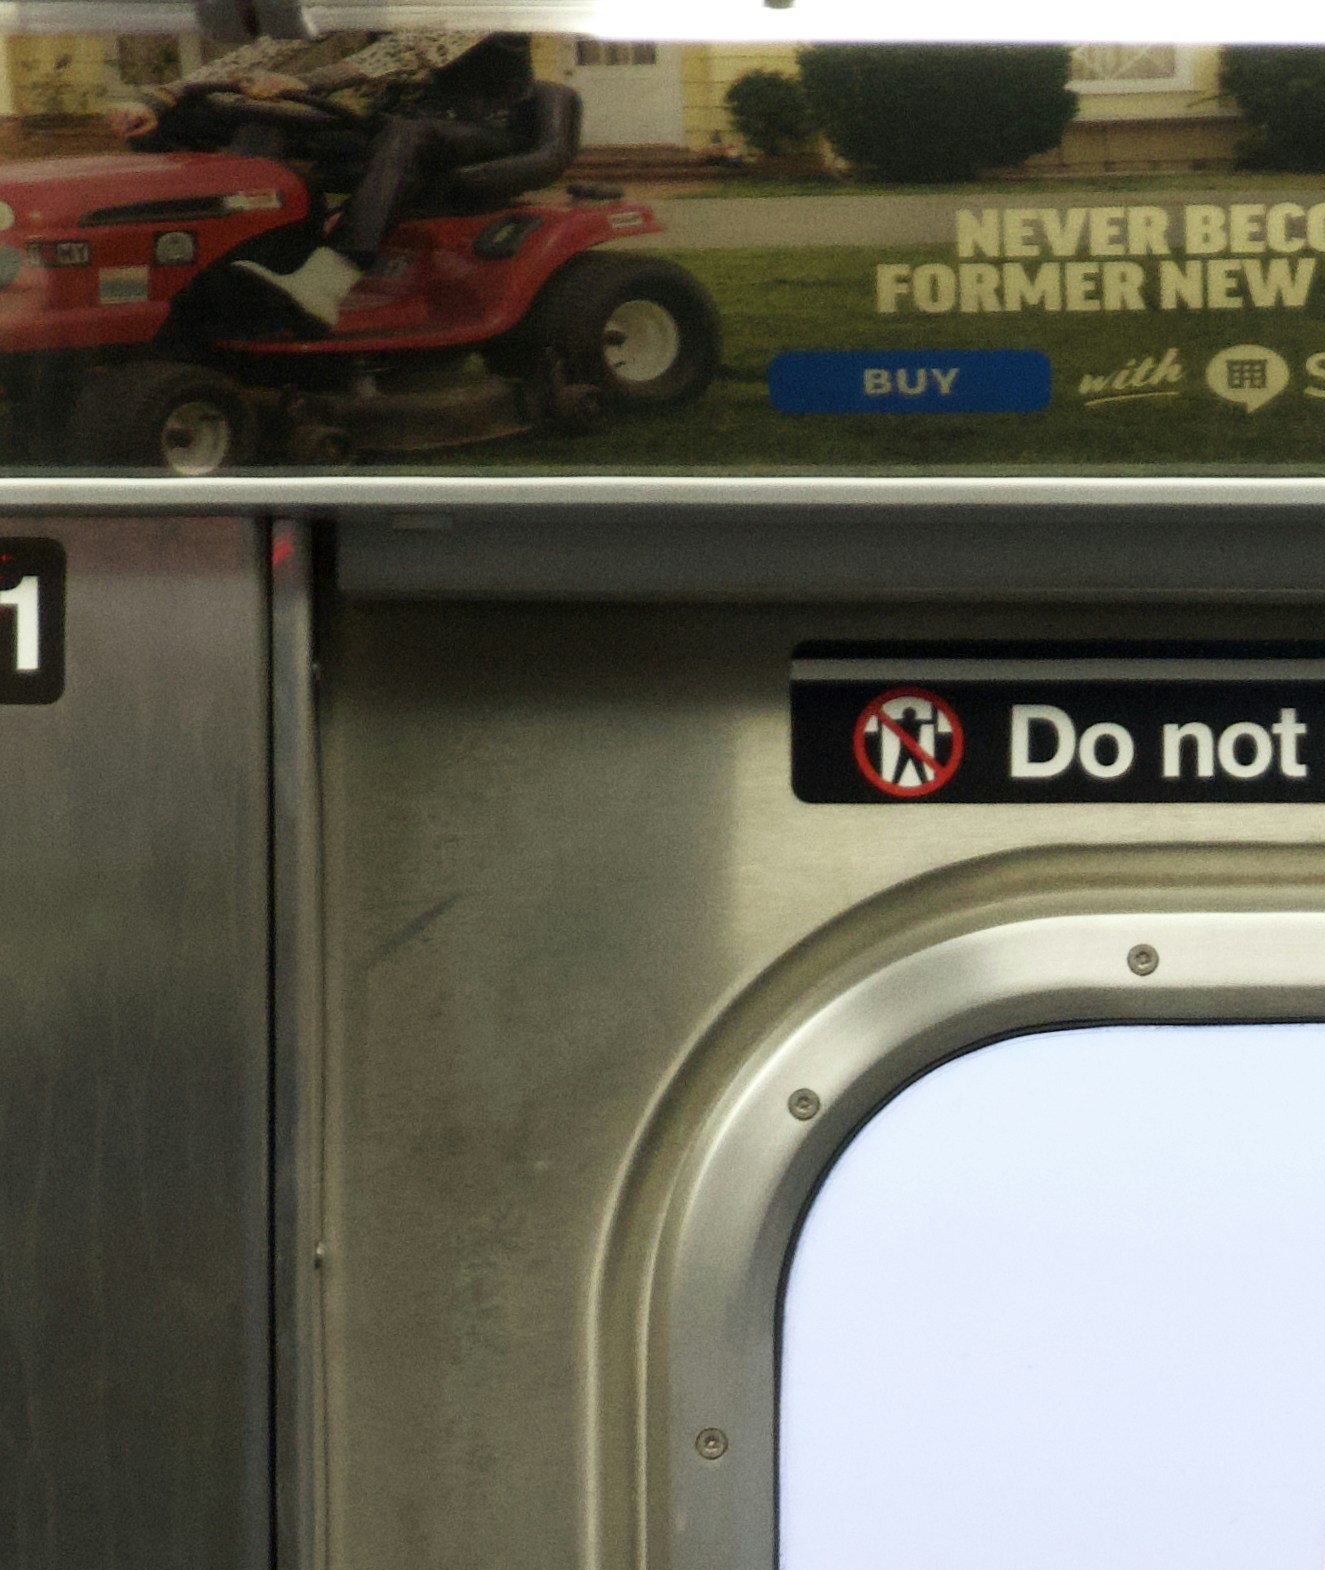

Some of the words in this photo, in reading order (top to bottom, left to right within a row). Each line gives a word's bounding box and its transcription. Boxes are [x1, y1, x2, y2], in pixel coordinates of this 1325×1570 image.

[954, 206, 1171, 259] NEVER
[876, 261, 1147, 314] FORMER
[1157, 256, 1316, 310] NEW
[863, 367, 960, 396] BUY
[1078, 346, 1184, 395] with
[1010, 703, 1135, 779] Do
[1162, 706, 1308, 779] not
